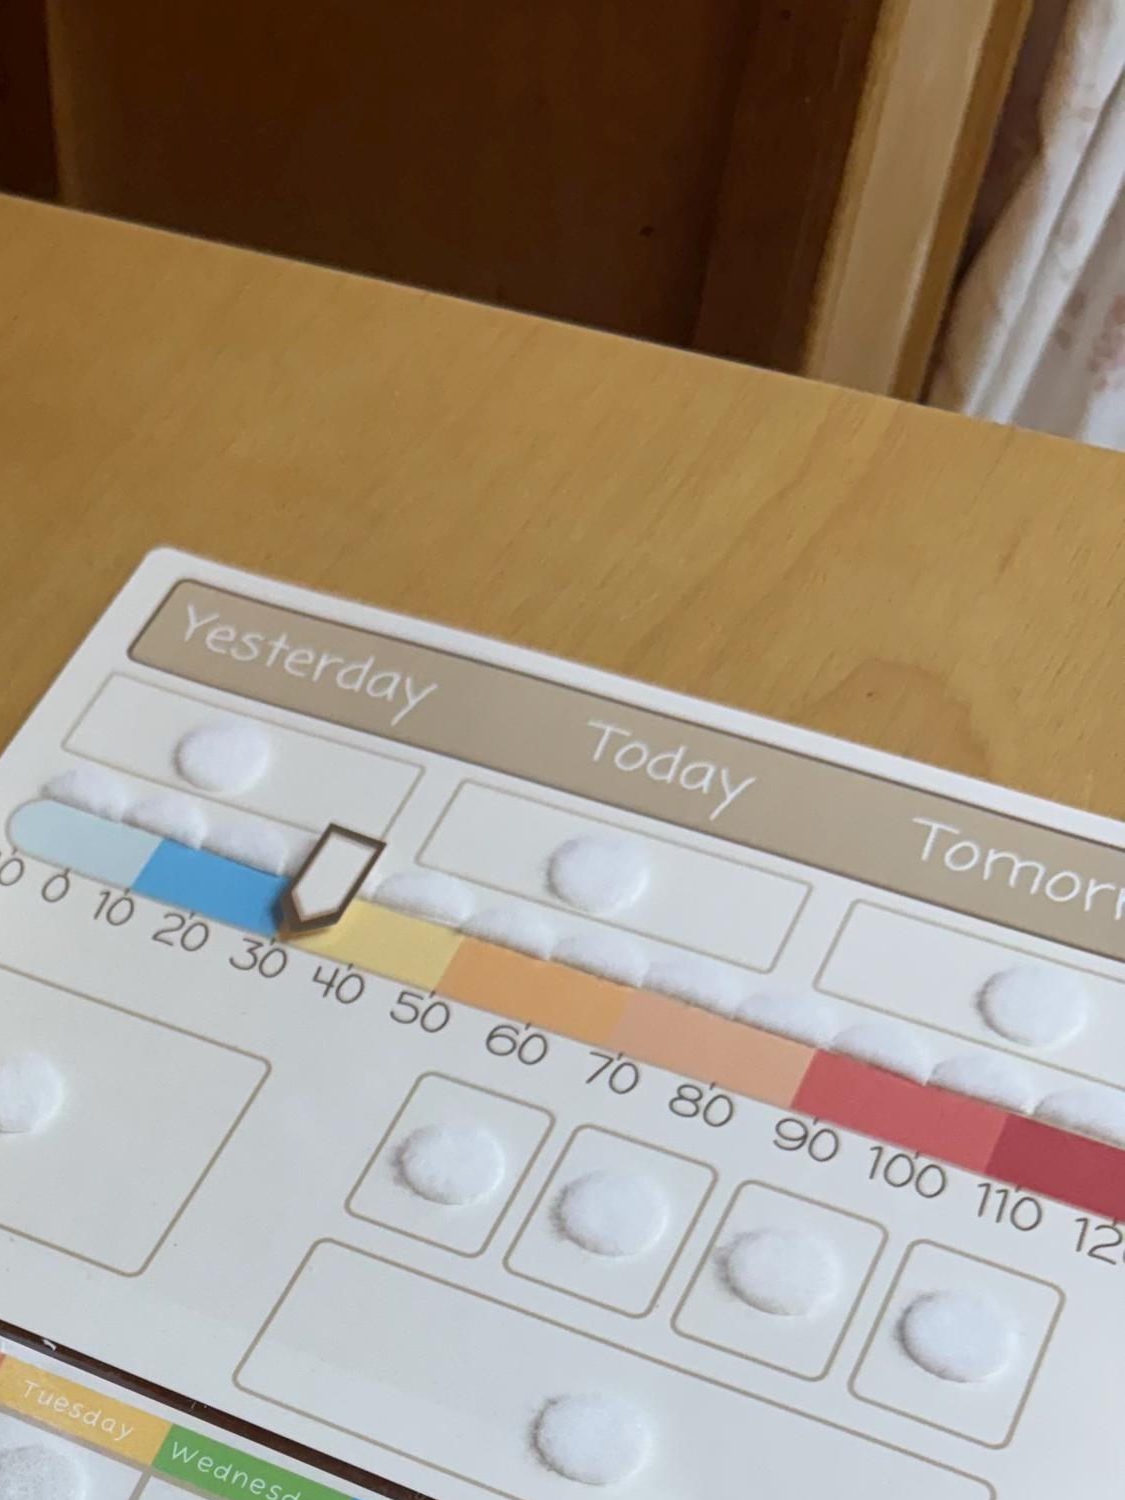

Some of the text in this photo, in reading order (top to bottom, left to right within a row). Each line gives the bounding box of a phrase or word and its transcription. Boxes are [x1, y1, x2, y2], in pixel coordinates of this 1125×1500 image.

[181, 603, 438, 726] Yesterday
[586, 719, 757, 820] Today
[41, 873, 70, 903] 0
[92, 890, 135, 926] 10
[151, 912, 210, 951] 20
[229, 937, 288, 978] 30
[312, 965, 365, 1004] 40
[390, 990, 451, 1033] 50
[485, 1024, 549, 1065] 60
[585, 1050, 640, 1094] 70
[668, 1083, 735, 1127] 80
[772, 1117, 840, 1163] 90
[868, 1145, 948, 1199] 100
[975, 1182, 1043, 1232] 110
[1075, 1217, 1125, 1265] 12
[23, 1379, 135, 1442] Tuesday
